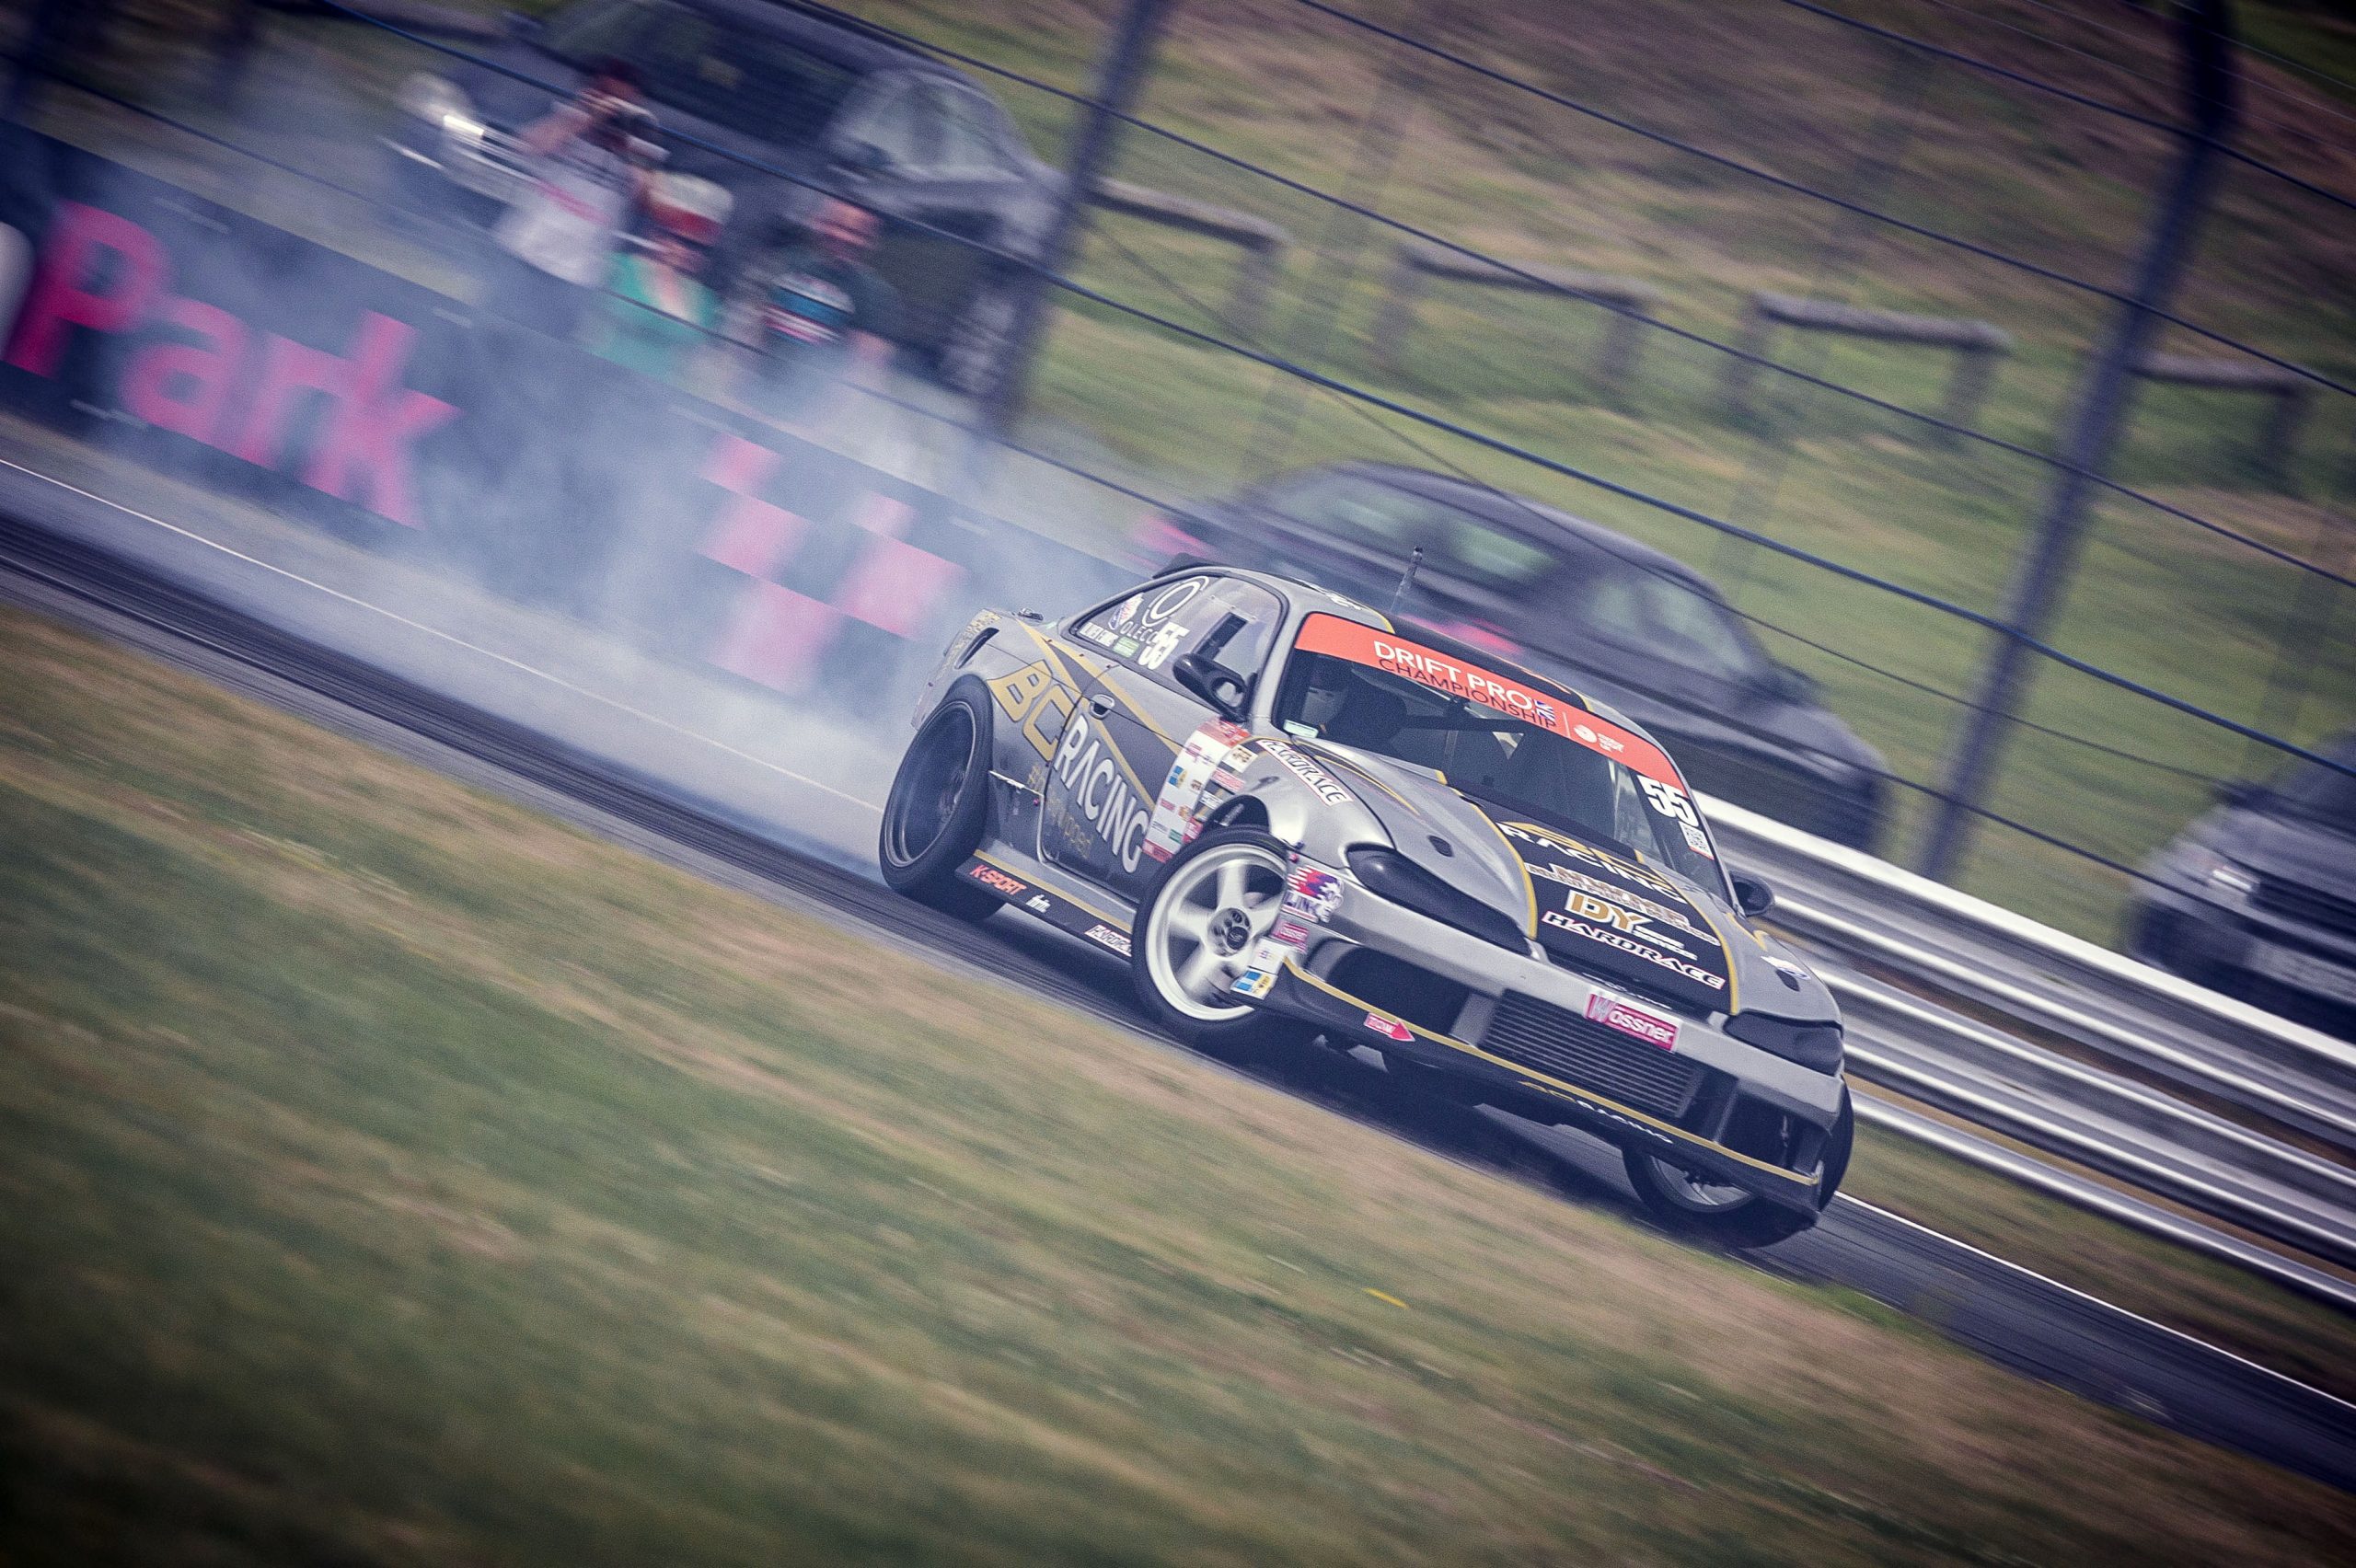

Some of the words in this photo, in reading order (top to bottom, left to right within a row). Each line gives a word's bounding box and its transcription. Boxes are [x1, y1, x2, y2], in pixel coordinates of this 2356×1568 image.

[6, 199, 459, 531] Park
[1138, 622, 1190, 670] 55
[1373, 640, 1461, 683] DRIFT
[1467, 673, 1533, 710] PRO
[987, 660, 1079, 762] BC
[1379, 658, 1556, 729] CHAMPIONSHIP
[1054, 713, 1149, 873] RACING
[1637, 774, 1700, 827] 55
[1496, 822, 1688, 905] RACING
[1566, 891, 1652, 933] DY
[1545, 913, 1726, 988] HARDRACE
